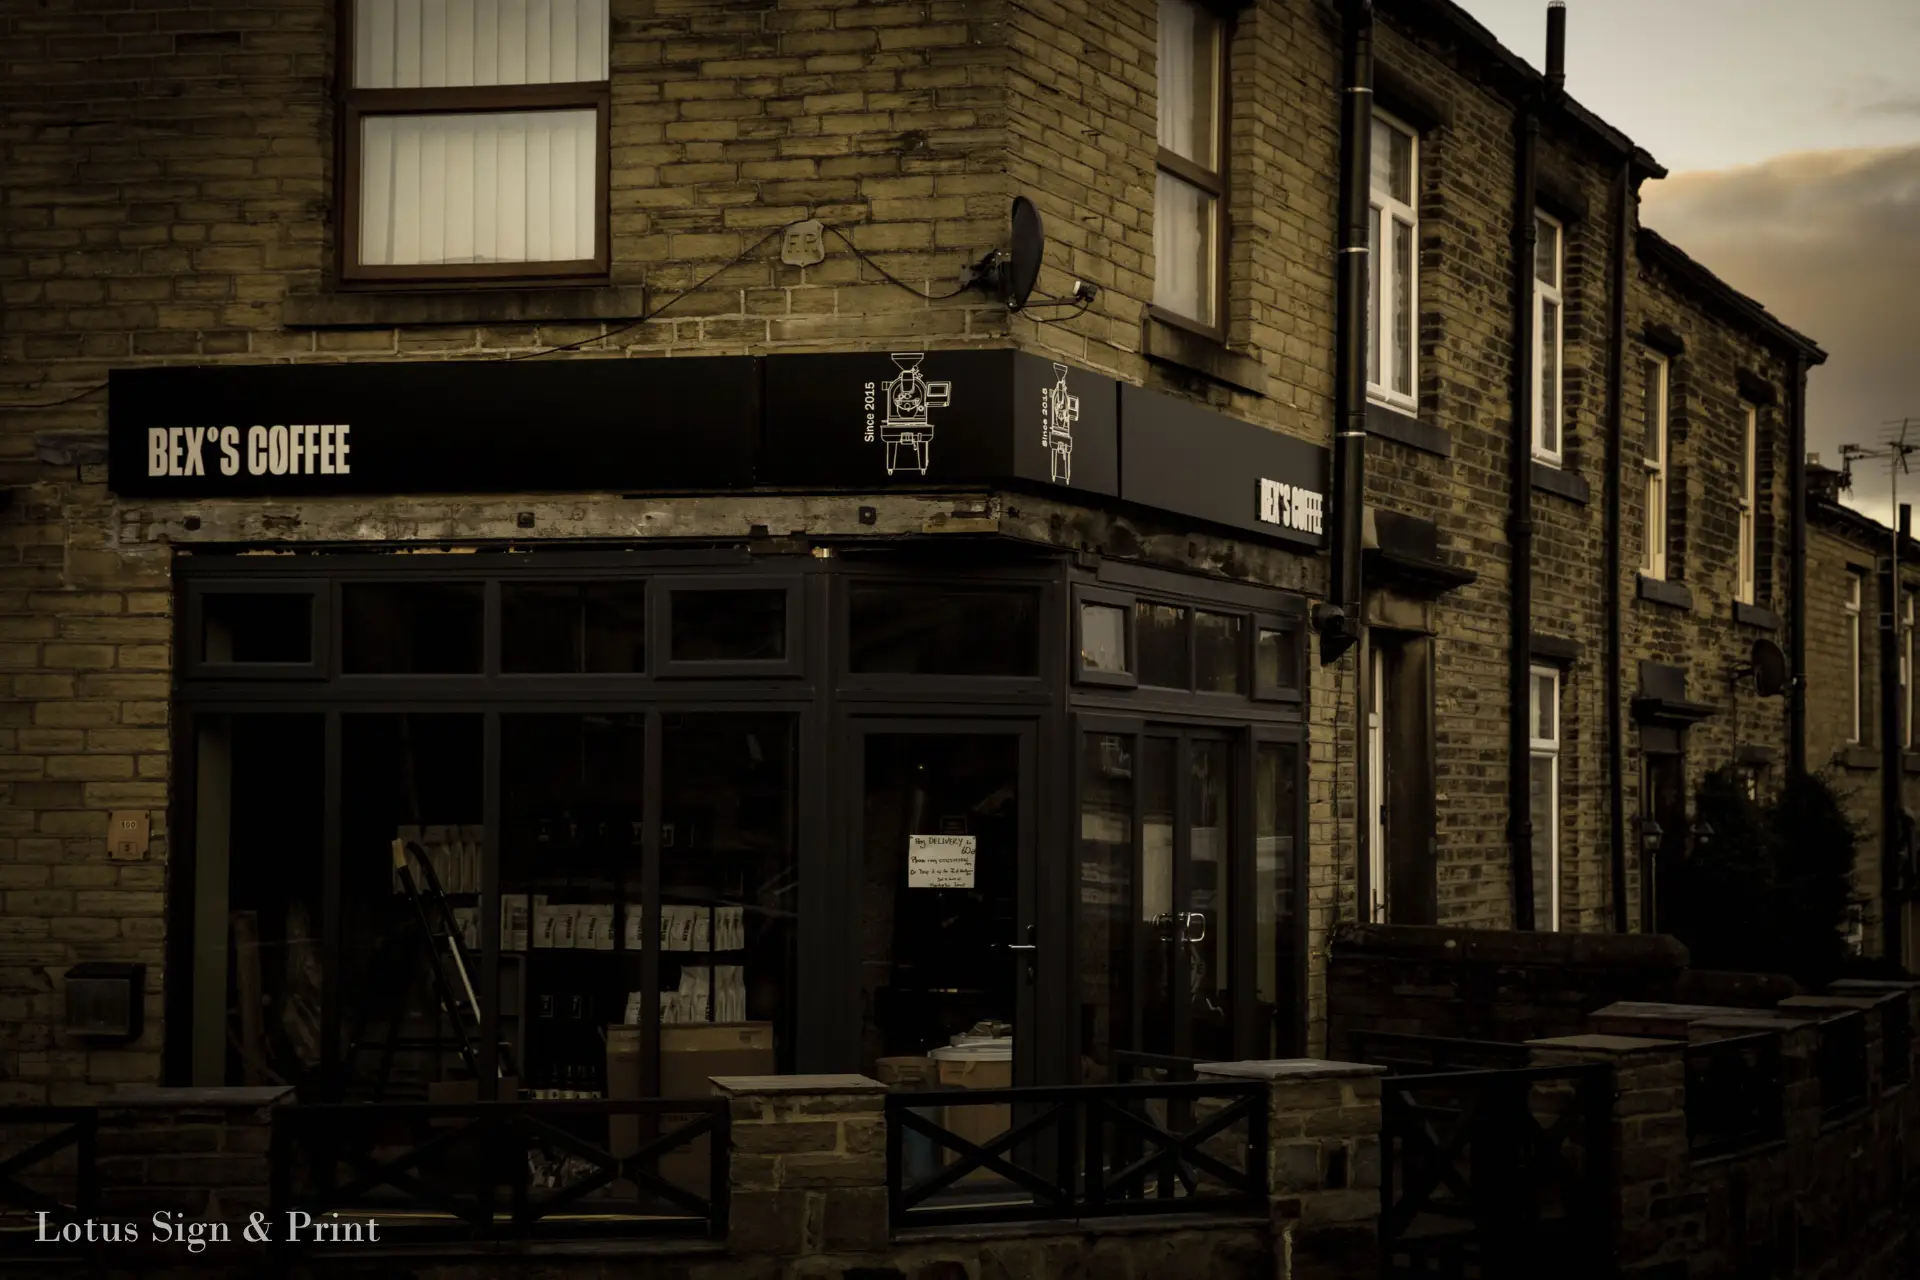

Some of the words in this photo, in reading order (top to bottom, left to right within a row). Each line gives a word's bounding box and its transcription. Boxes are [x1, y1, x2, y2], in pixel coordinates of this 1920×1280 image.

[864, 382, 875, 410] 2015
[864, 413, 875, 443] Since
[1041, 418, 1052, 448] Since
[247, 424, 351, 475] COFFEE
[1291, 485, 1323, 535] COFFEE
[121, 821, 136, 829] 100
[928, 837, 963, 847] DELIVERY
